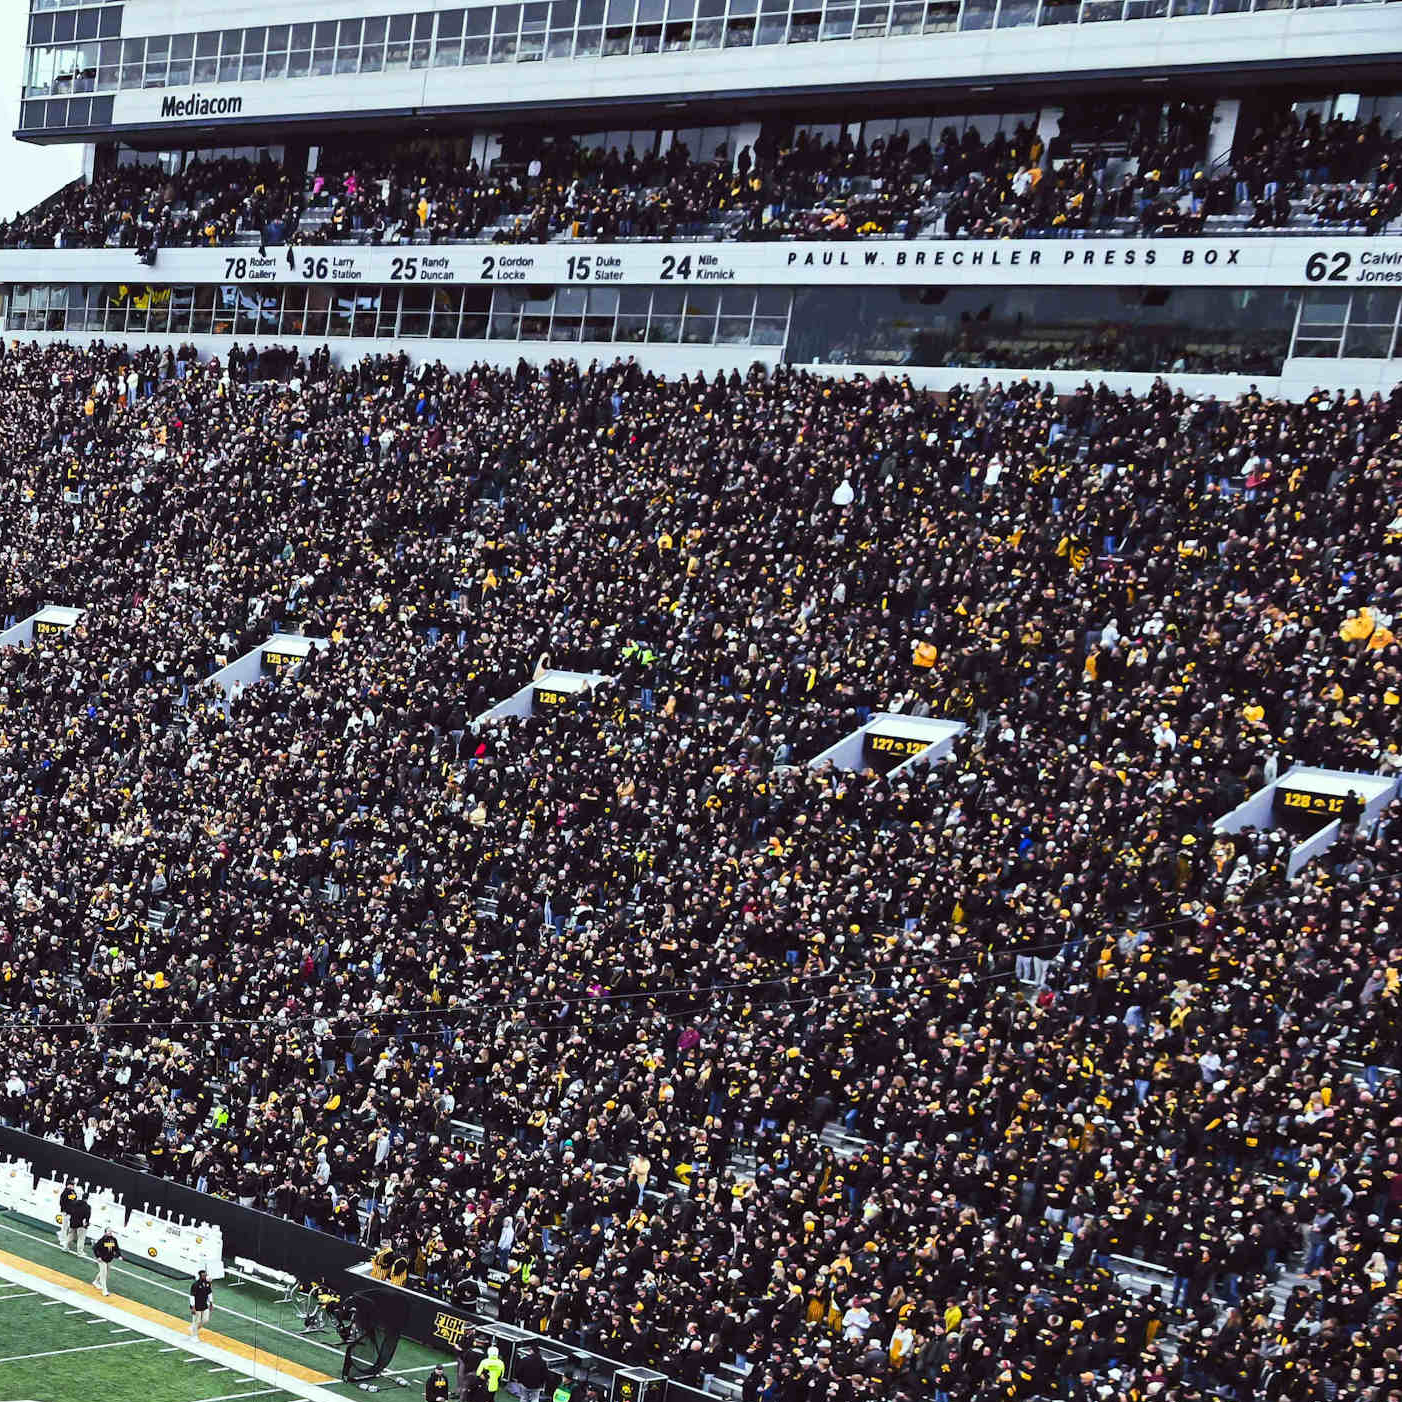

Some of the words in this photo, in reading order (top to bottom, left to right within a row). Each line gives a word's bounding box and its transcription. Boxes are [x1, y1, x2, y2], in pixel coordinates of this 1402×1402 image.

[161, 93, 242, 117] Mediacom
[250, 257, 276, 266] Robert
[333, 257, 354, 267] Larry
[422, 256, 450, 269] Randy
[499, 256, 534, 267] Gordon
[596, 256, 621, 267] Duke
[698, 255, 718, 266] Nile
[787, 251, 849, 266] PAUL
[864, 251, 884, 266] W.
[896, 251, 1042, 266] BRECHLER
[1063, 250, 1157, 266] PRESS
[1182, 249, 1240, 266] BOX
[225, 258, 246, 279] 78
[302, 257, 328, 279] 36
[391, 258, 417, 280] 25
[481, 256, 495, 280] 2
[566, 256, 591, 280] 15
[660, 256, 691, 280] 24
[1305, 252, 1352, 282] 62
[249, 270, 276, 280] Gallery
[332, 270, 361, 279] Station
[421, 269, 454, 280] Duncan
[497, 270, 526, 280] Locke
[595, 270, 624, 281] Slater
[696, 269, 735, 280] Kinnick
[1356, 269, 1402, 282] Jones
[872, 737, 894, 751] 127
[1284, 792, 1311, 808] 128
